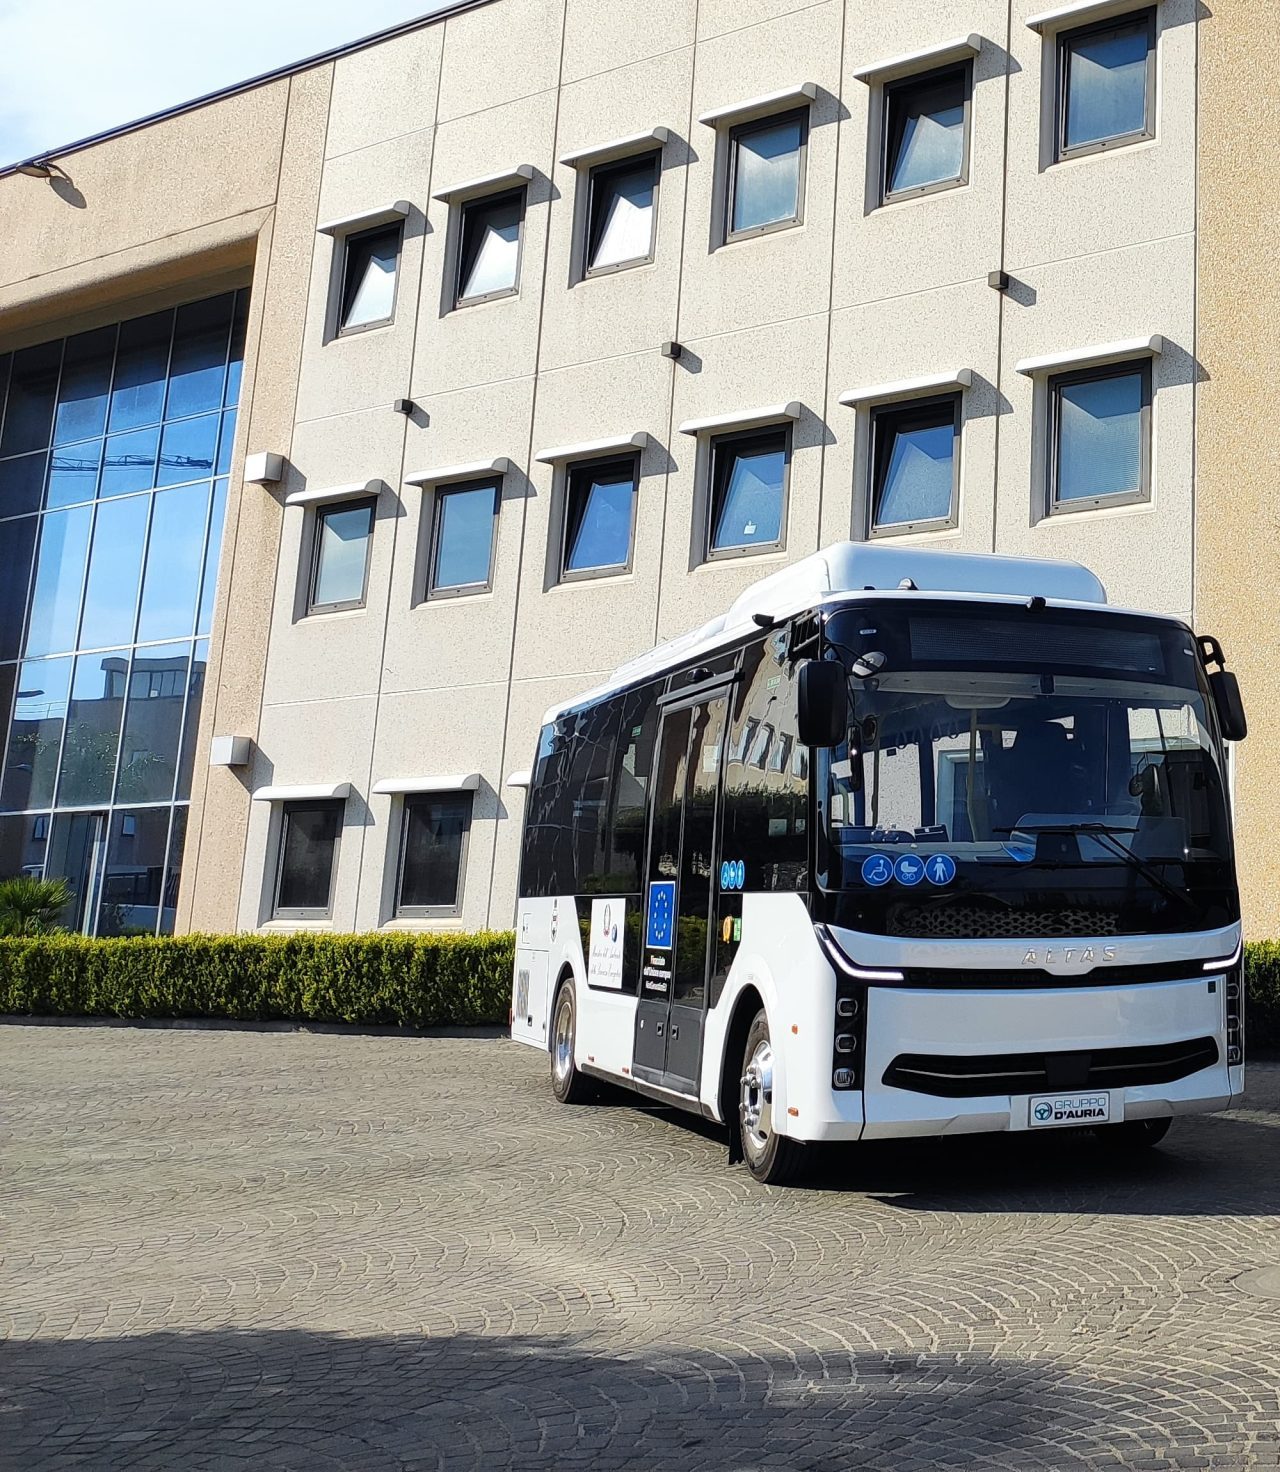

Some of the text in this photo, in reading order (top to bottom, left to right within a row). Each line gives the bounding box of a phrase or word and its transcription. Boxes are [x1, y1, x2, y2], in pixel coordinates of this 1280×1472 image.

[1022, 945, 1117, 964] ALTAS
[1054, 1097, 1106, 1110] GRUPPO
[1054, 1108, 1105, 1121] D'AURIA
